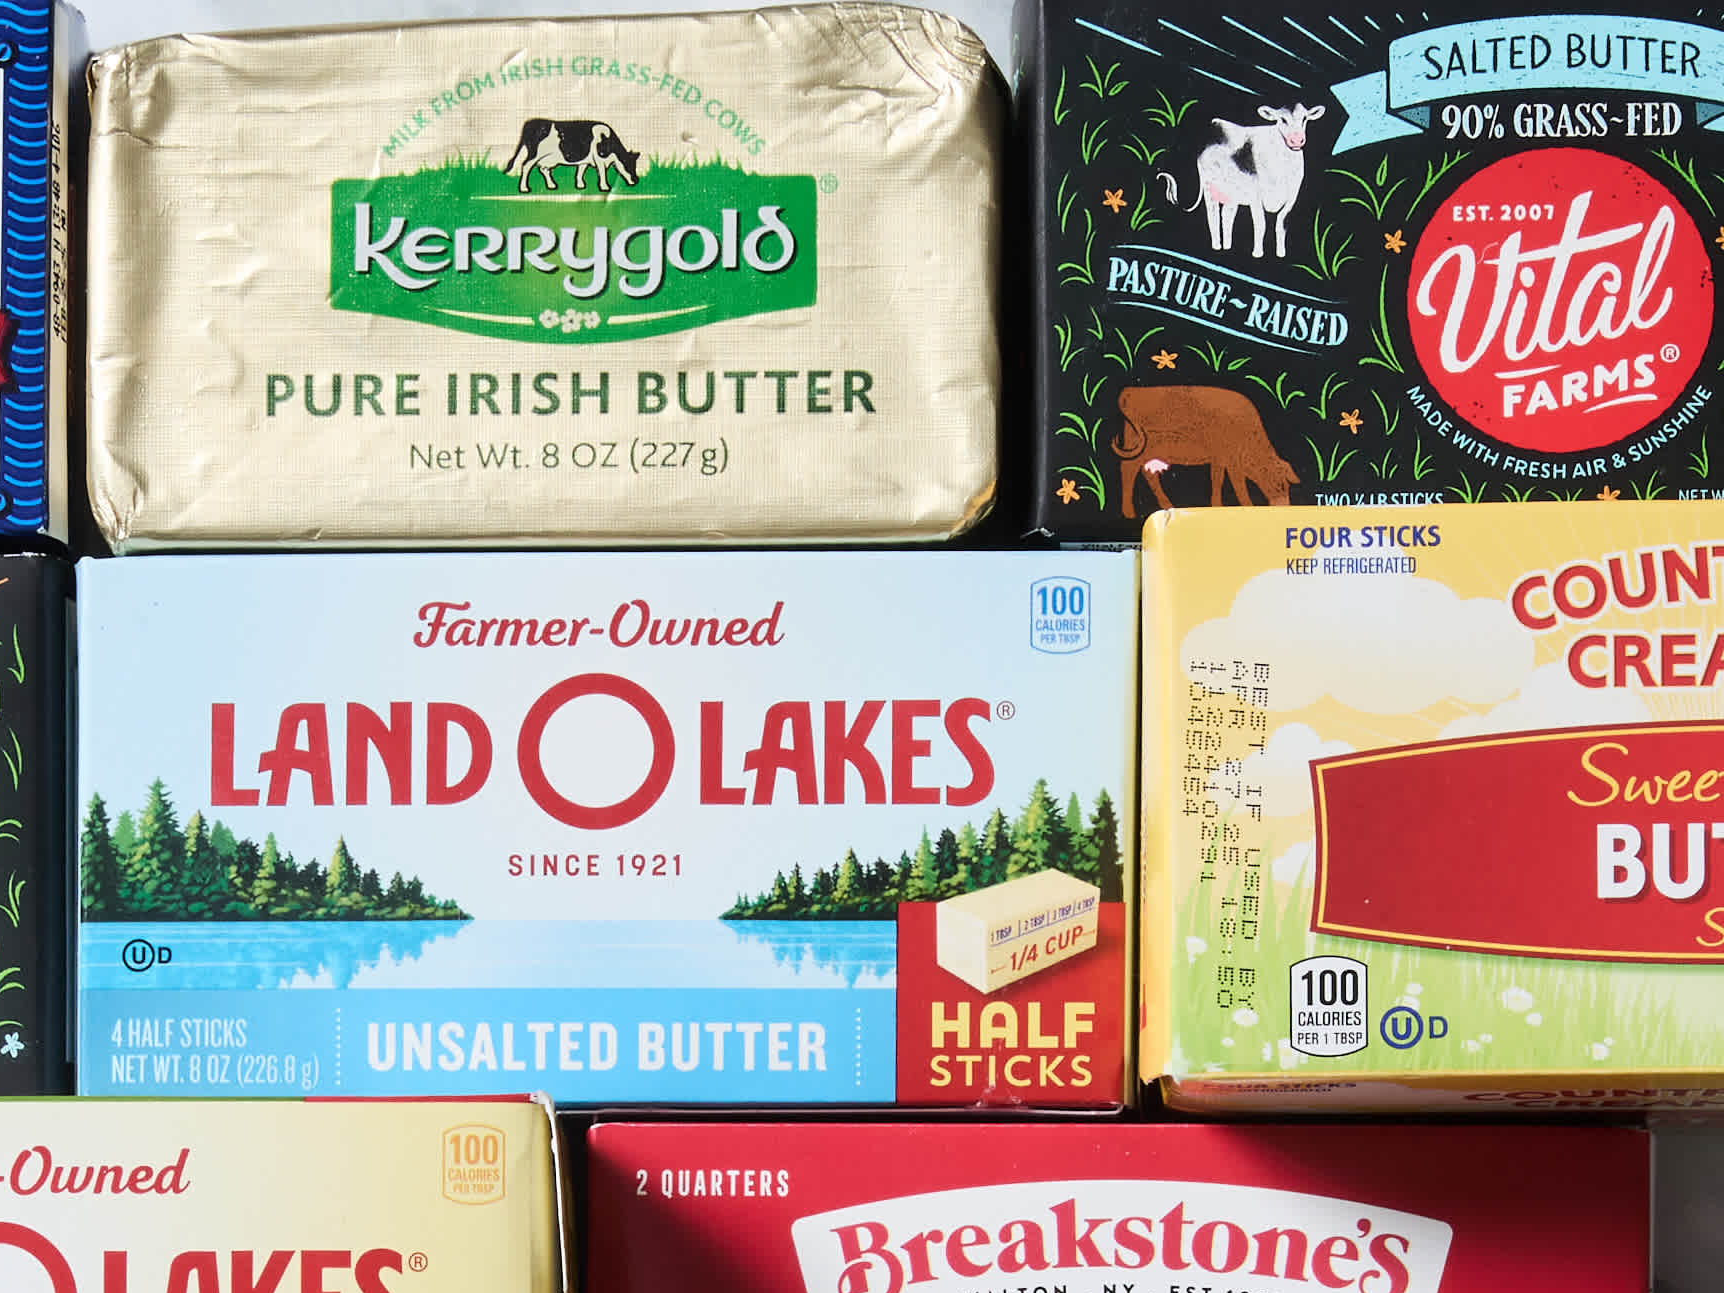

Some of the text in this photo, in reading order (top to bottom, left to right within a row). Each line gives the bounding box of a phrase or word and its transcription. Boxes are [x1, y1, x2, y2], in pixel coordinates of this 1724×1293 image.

[1424, 32, 1701, 80] SALTED BUTTER
[383, 56, 767, 159] MILK FROM IRISH GRASS-FED COWS
[1442, 104, 1504, 138] 90%
[1417, 190, 1675, 372] Vital
[266, 369, 876, 417] PURE IRISH BUTTER
[1503, 354, 1655, 418] FARMS
[1406, 383, 1712, 480] MADE WITH FRESH AIR & SUNSHINE
[1285, 526, 1441, 548] FOUR STICKS
[1286, 557, 1416, 575] KEEP REFRIGERATED
[413, 600, 785, 648] Farmer-Owned
[1037, 587, 1084, 615] 100
[1036, 619, 1086, 632] CALORIES
[211, 672, 996, 830] LAND O LAKES
[508, 854, 683, 876] SINCE 1921
[1010, 926, 1084, 971] 1/4 CUP
[367, 1022, 826, 1071] UNSALTED BUTTER
[932, 1002, 1096, 1048] HALF
[930, 1055, 1092, 1088] STICKS
